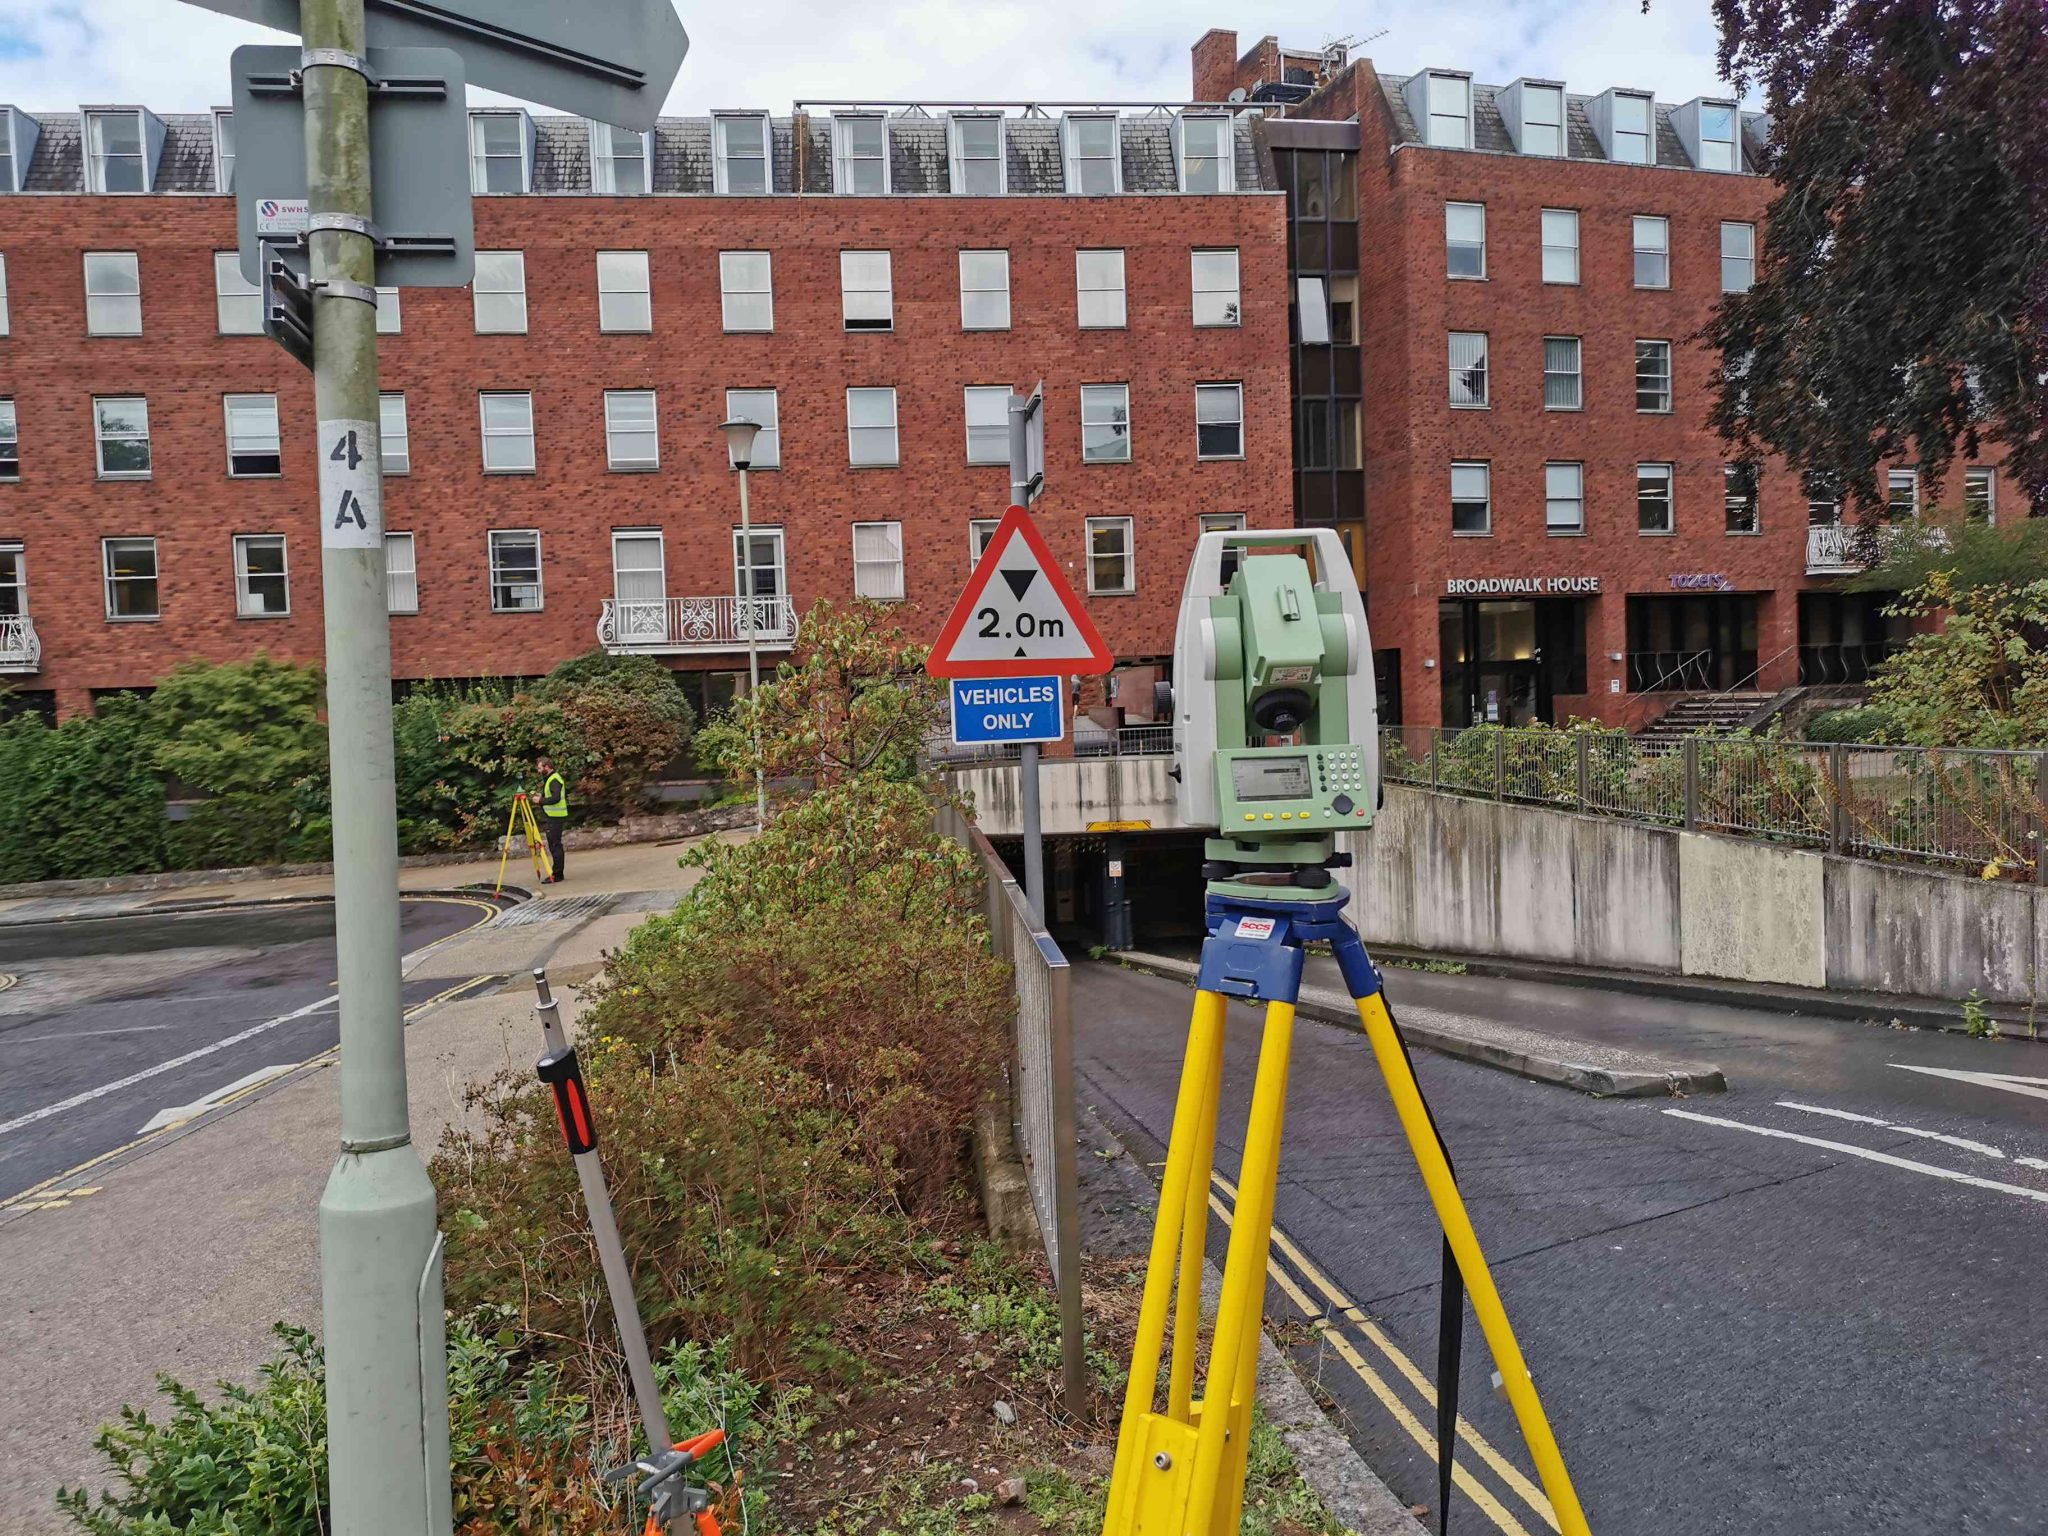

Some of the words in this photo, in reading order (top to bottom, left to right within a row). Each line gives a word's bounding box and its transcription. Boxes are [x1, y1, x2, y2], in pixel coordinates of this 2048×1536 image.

[330, 430, 363, 470] 4
[334, 489, 367, 530] A
[1446, 577, 1542, 593] BROADWALK
[1547, 576, 1598, 592] HOUSE
[977, 607, 1064, 639] 2.0m
[959, 686, 1055, 705] VEHICLES
[983, 712, 1034, 730] ONLY
